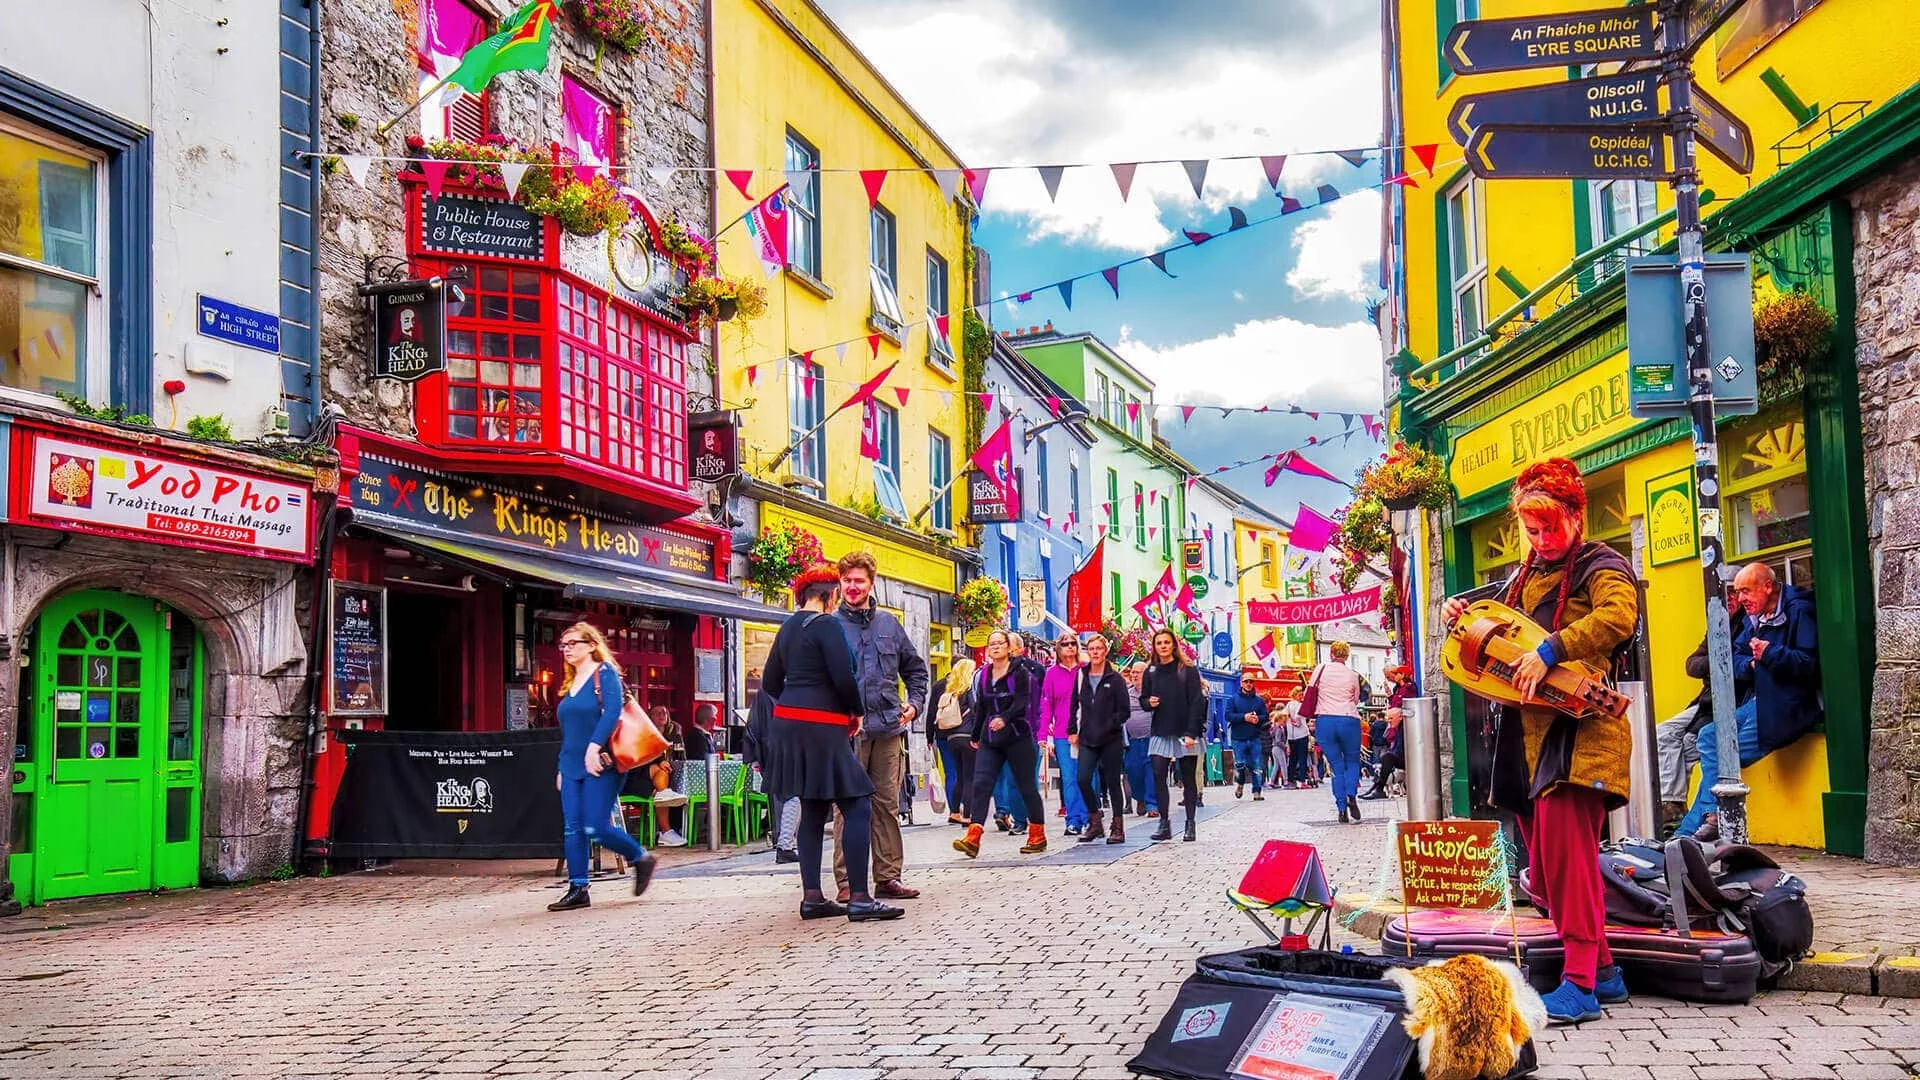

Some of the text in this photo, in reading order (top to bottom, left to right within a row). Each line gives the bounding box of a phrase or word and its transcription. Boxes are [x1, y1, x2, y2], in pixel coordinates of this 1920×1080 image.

[1511, 17, 1640, 41] An Fhaiche Mhór
[1527, 34, 1642, 58] EYRE SQUARE
[1587, 80, 1645, 100] Ollscoil
[1590, 99, 1648, 118] N.U.I.G.
[1590, 135, 1651, 151] Ospidéal
[1594, 154, 1652, 168] U.C.H.G.
[435, 205, 530, 230] Public House
[433, 226, 534, 249] & Restaurant
[388, 293, 425, 305] GUINNESS
[220, 321, 278, 345] HIGH STREET
[388, 359, 425, 373] HEAD
[1510, 370, 1630, 467] EVERGRE
[1461, 443, 1499, 475] HEALTH
[358, 472, 382, 487] Since
[696, 467, 724, 477] HEAD
[127, 460, 281, 514] Yod Pho
[361, 486, 380, 506] 1649
[106, 491, 292, 536] Traditional Thai Massage
[973, 503, 1007, 515] BISTR
[1653, 498, 1690, 534] EVERGREEN
[153, 517, 250, 540] Tel: 089-2165894
[423, 481, 640, 558] The Kings Head
[1654, 532, 1691, 552] CORNER
[1291, 605, 1312, 620] ON
[1313, 595, 1371, 618] GALWAY
[437, 795, 469, 807] HEAD
[1424, 823, 1443, 835] It's
[1404, 860, 1417, 878] If
[1420, 865, 1434, 878] you
[1436, 864, 1458, 875] want
[1460, 866, 1469, 876] to
[1440, 877, 1450, 889] be
[1416, 891, 1477, 908] Ask and TIP first
